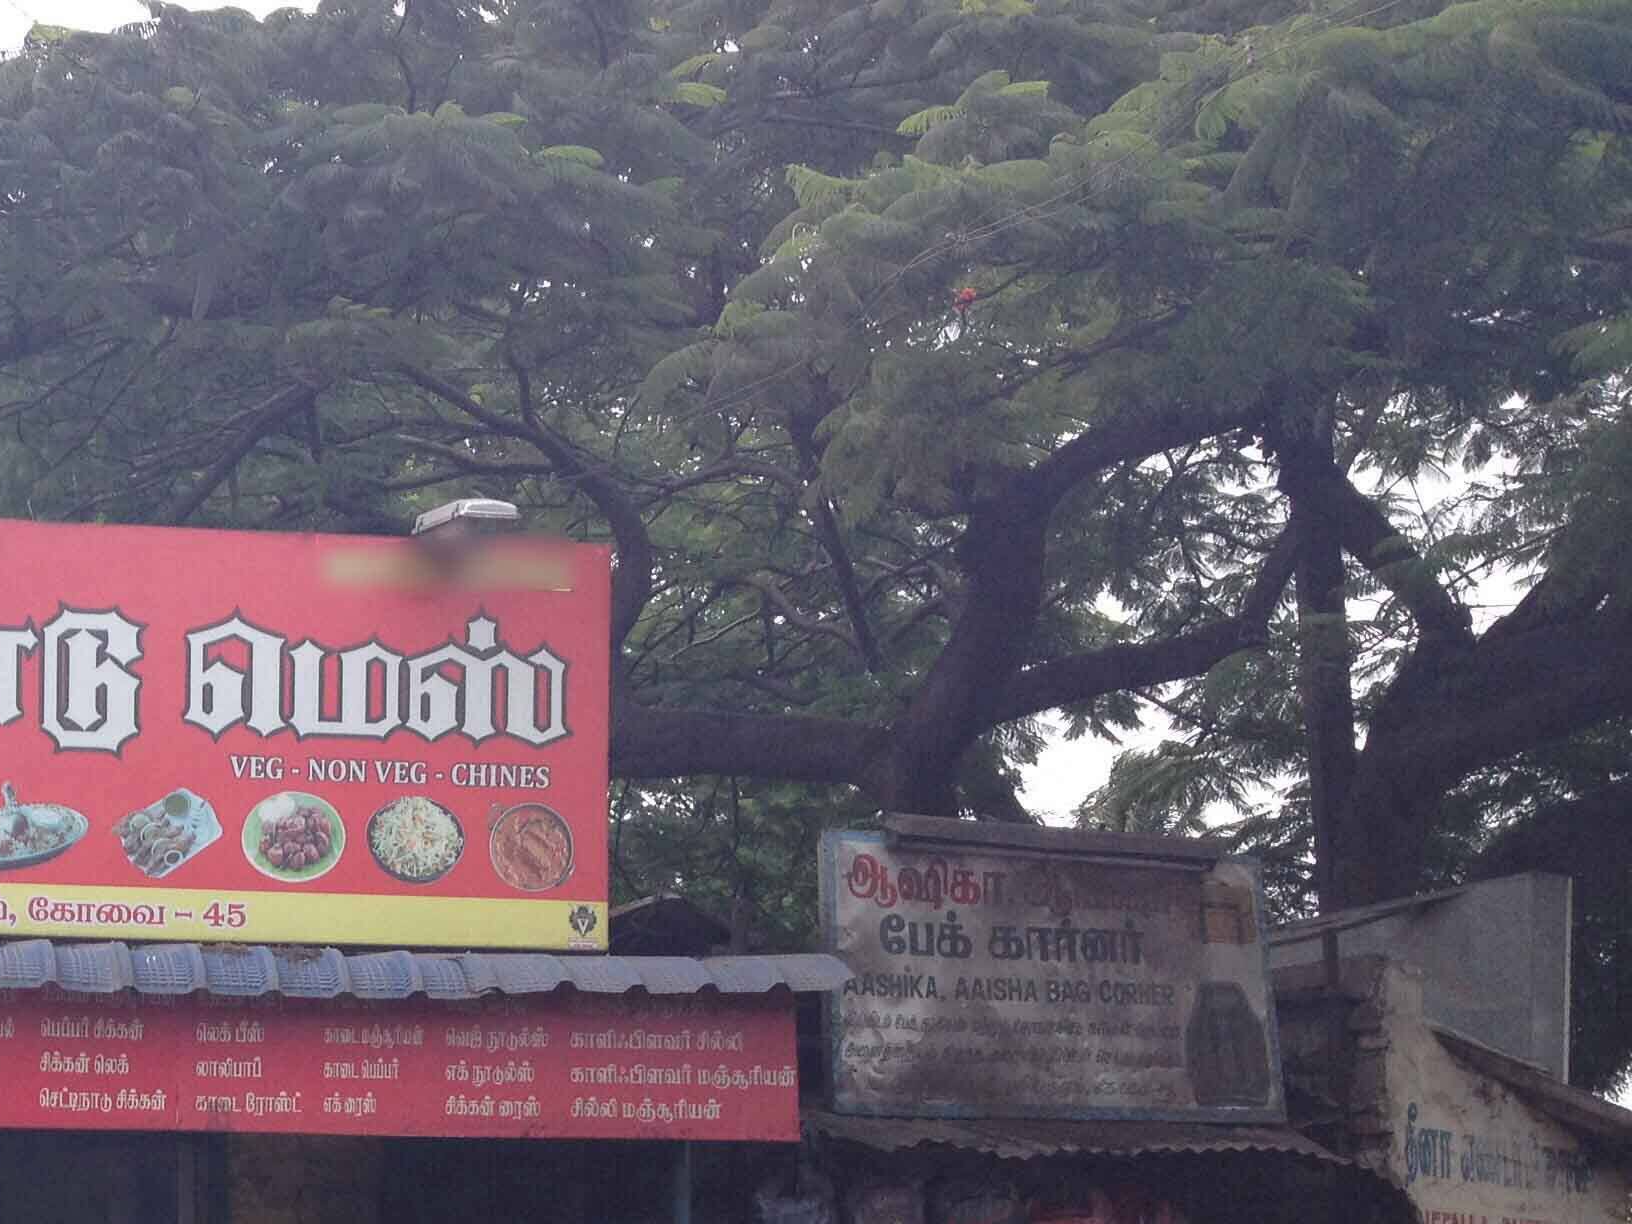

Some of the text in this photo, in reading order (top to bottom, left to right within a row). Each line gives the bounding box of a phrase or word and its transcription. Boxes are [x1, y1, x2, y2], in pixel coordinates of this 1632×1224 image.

[183, 605, 571, 748] மெஸ்
[230, 754, 284, 780] VEG
[308, 757, 368, 784] NON
[374, 760, 428, 785] VEG
[451, 762, 551, 789] CHINES
[27, 897, 166, 925] கோவை
[202, 902, 248, 928] 45
[879, 911, 973, 960] பேக்
[955, 975, 1039, 1003] AAISHA
[1046, 978, 1091, 1004] BAG
[1099, 979, 1175, 1006] CORNER
[39, 1051, 130, 1076] சிக்கன் லெக்
[116, 1088, 168, 1111] சிக்கன்
